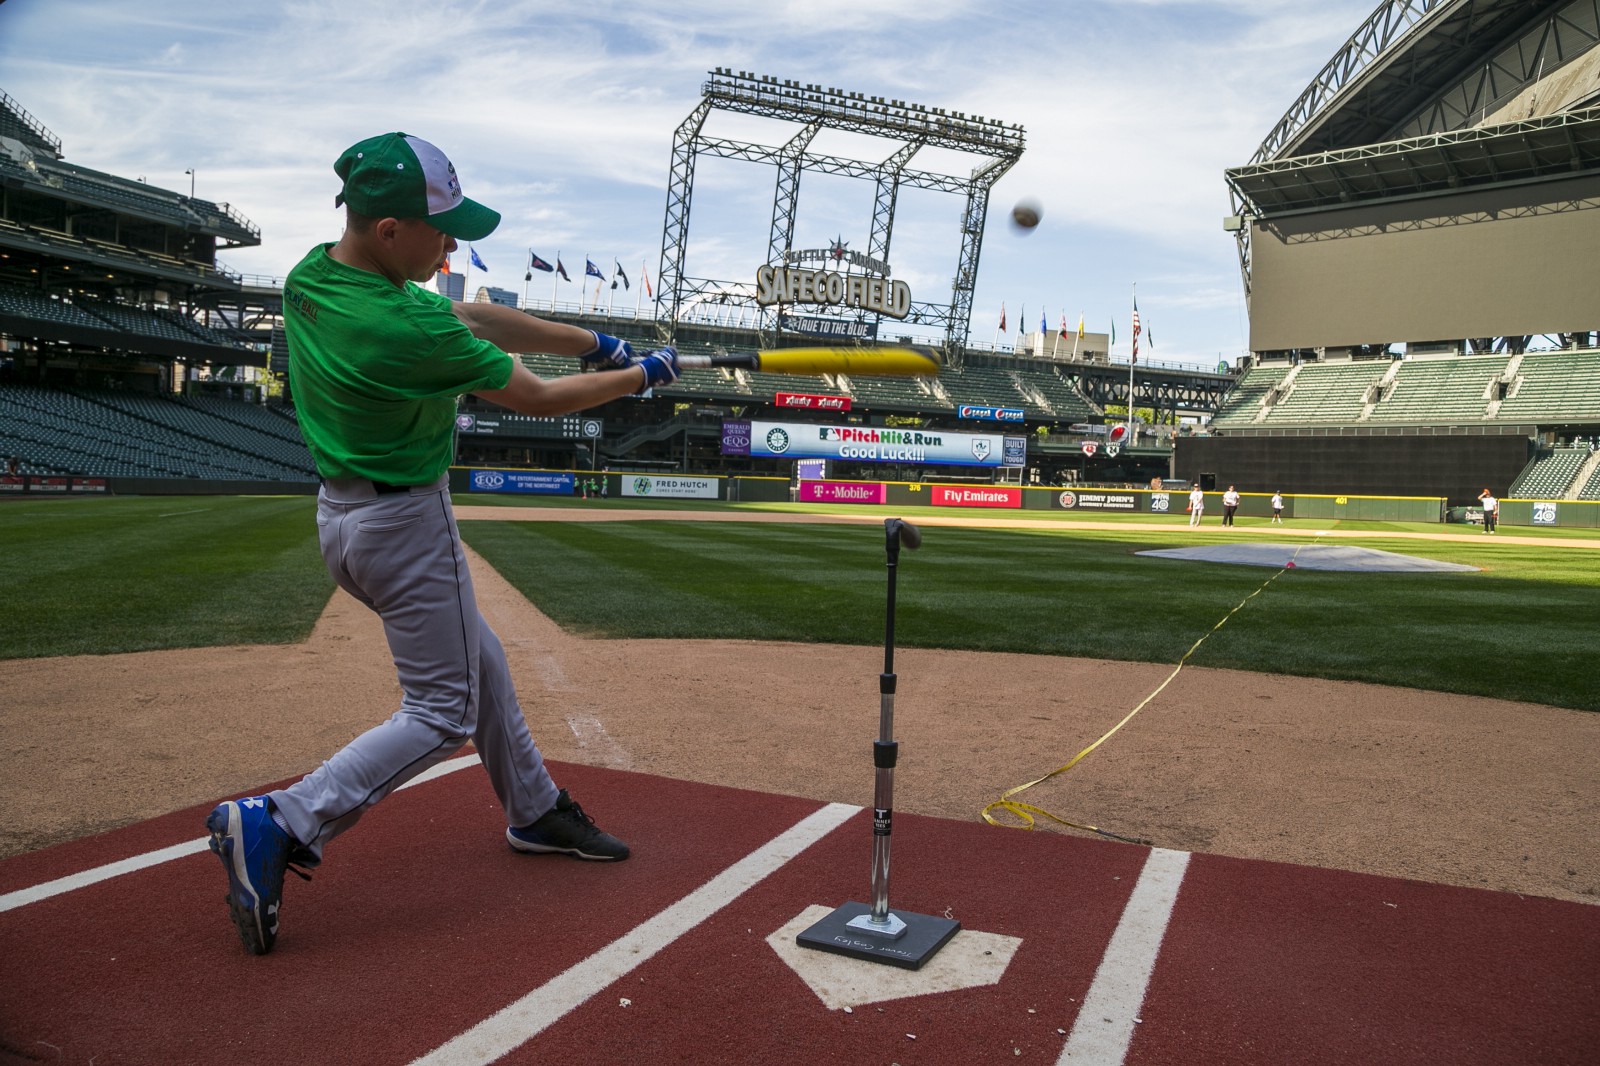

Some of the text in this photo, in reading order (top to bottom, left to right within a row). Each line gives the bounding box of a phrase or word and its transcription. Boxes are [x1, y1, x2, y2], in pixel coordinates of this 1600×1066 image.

[784, 248, 891, 277] SEATTLE MARINERS
[757, 264, 911, 319] SAFECO FIELD
[798, 316, 869, 336] TRUE TO THE BLUE
[1005, 440, 1024, 449] BUILT
[839, 444, 925, 461] Good Luck!!!
[475, 475, 504, 487] EQC
[944, 490, 1009, 503] Fly Emirates
[1079, 494, 1106, 502] JIMMY
[1106, 495, 1134, 504] JOHN'S
[1534, 510, 1556, 522] 40
[879, 947, 912, 958] Trevor
